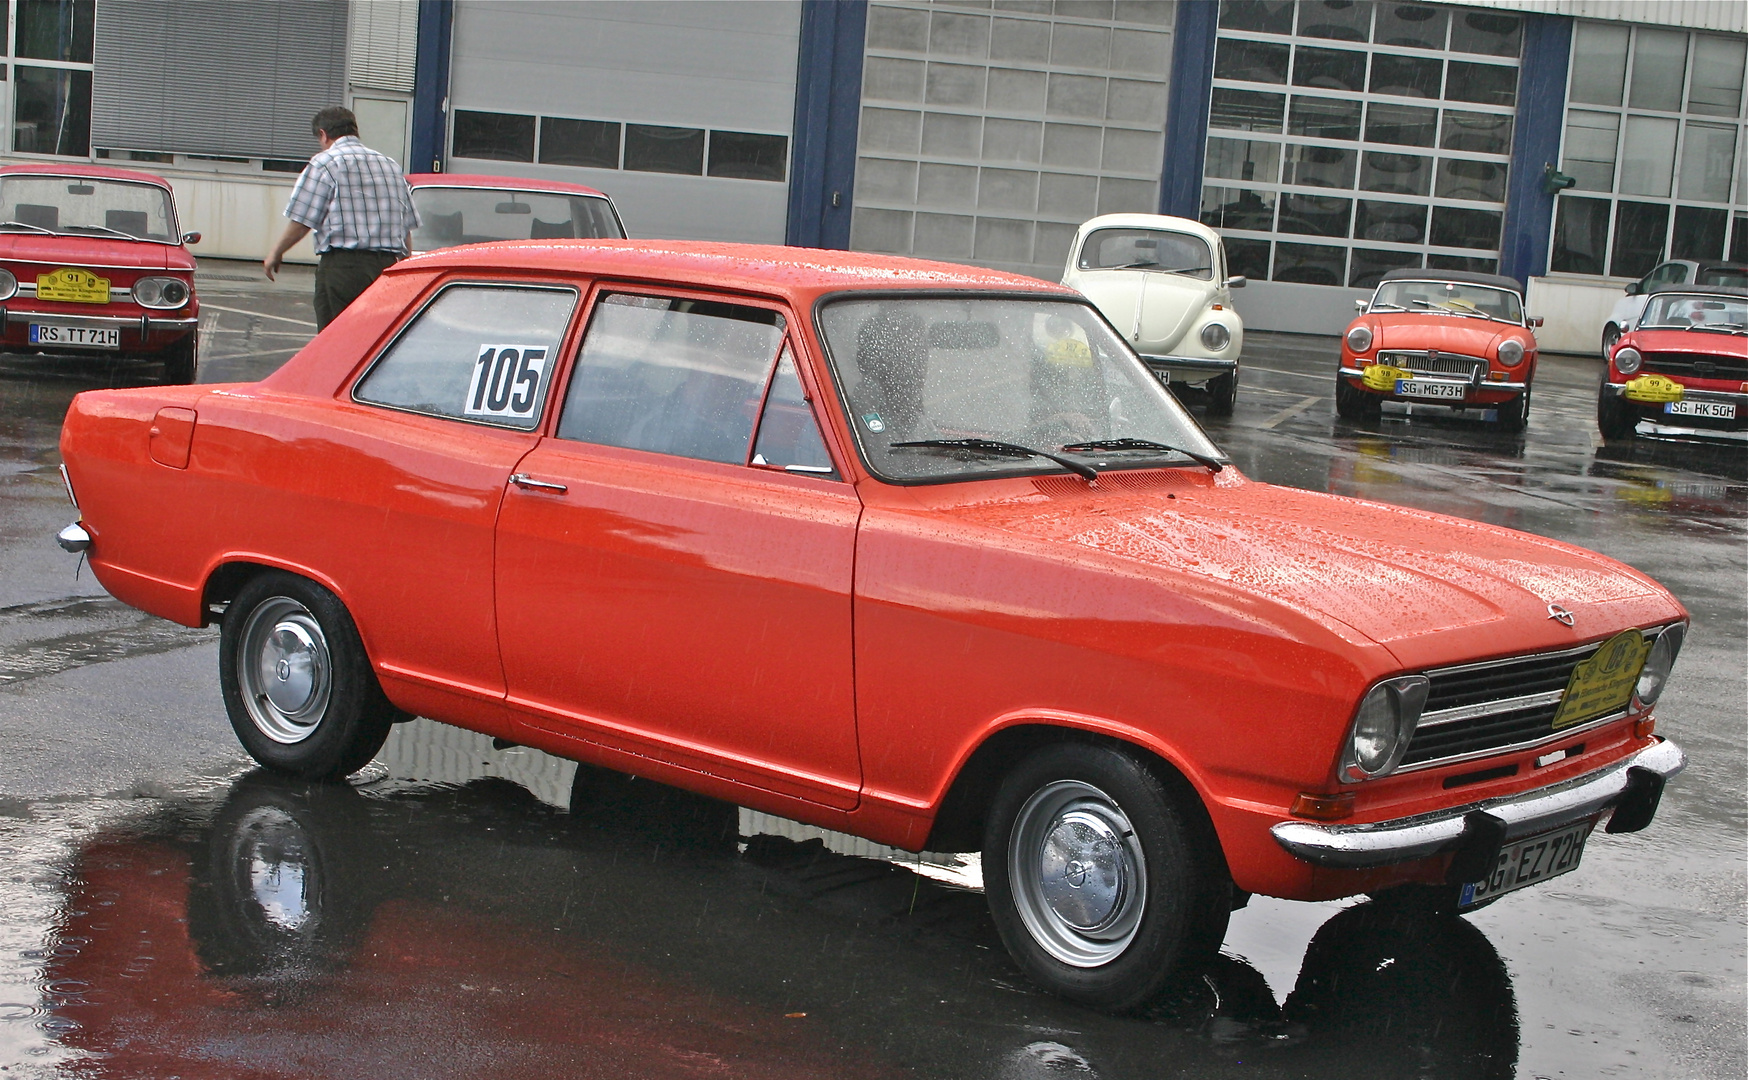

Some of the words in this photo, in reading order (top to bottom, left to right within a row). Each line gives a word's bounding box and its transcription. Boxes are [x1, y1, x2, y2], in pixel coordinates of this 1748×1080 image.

[67, 273, 79, 283] 91
[40, 327, 59, 341] RS
[472, 348, 546, 414] 105
[1649, 379, 1660, 387] 99
[1402, 383, 1417, 394] SG
[1672, 402, 1688, 413] SG
